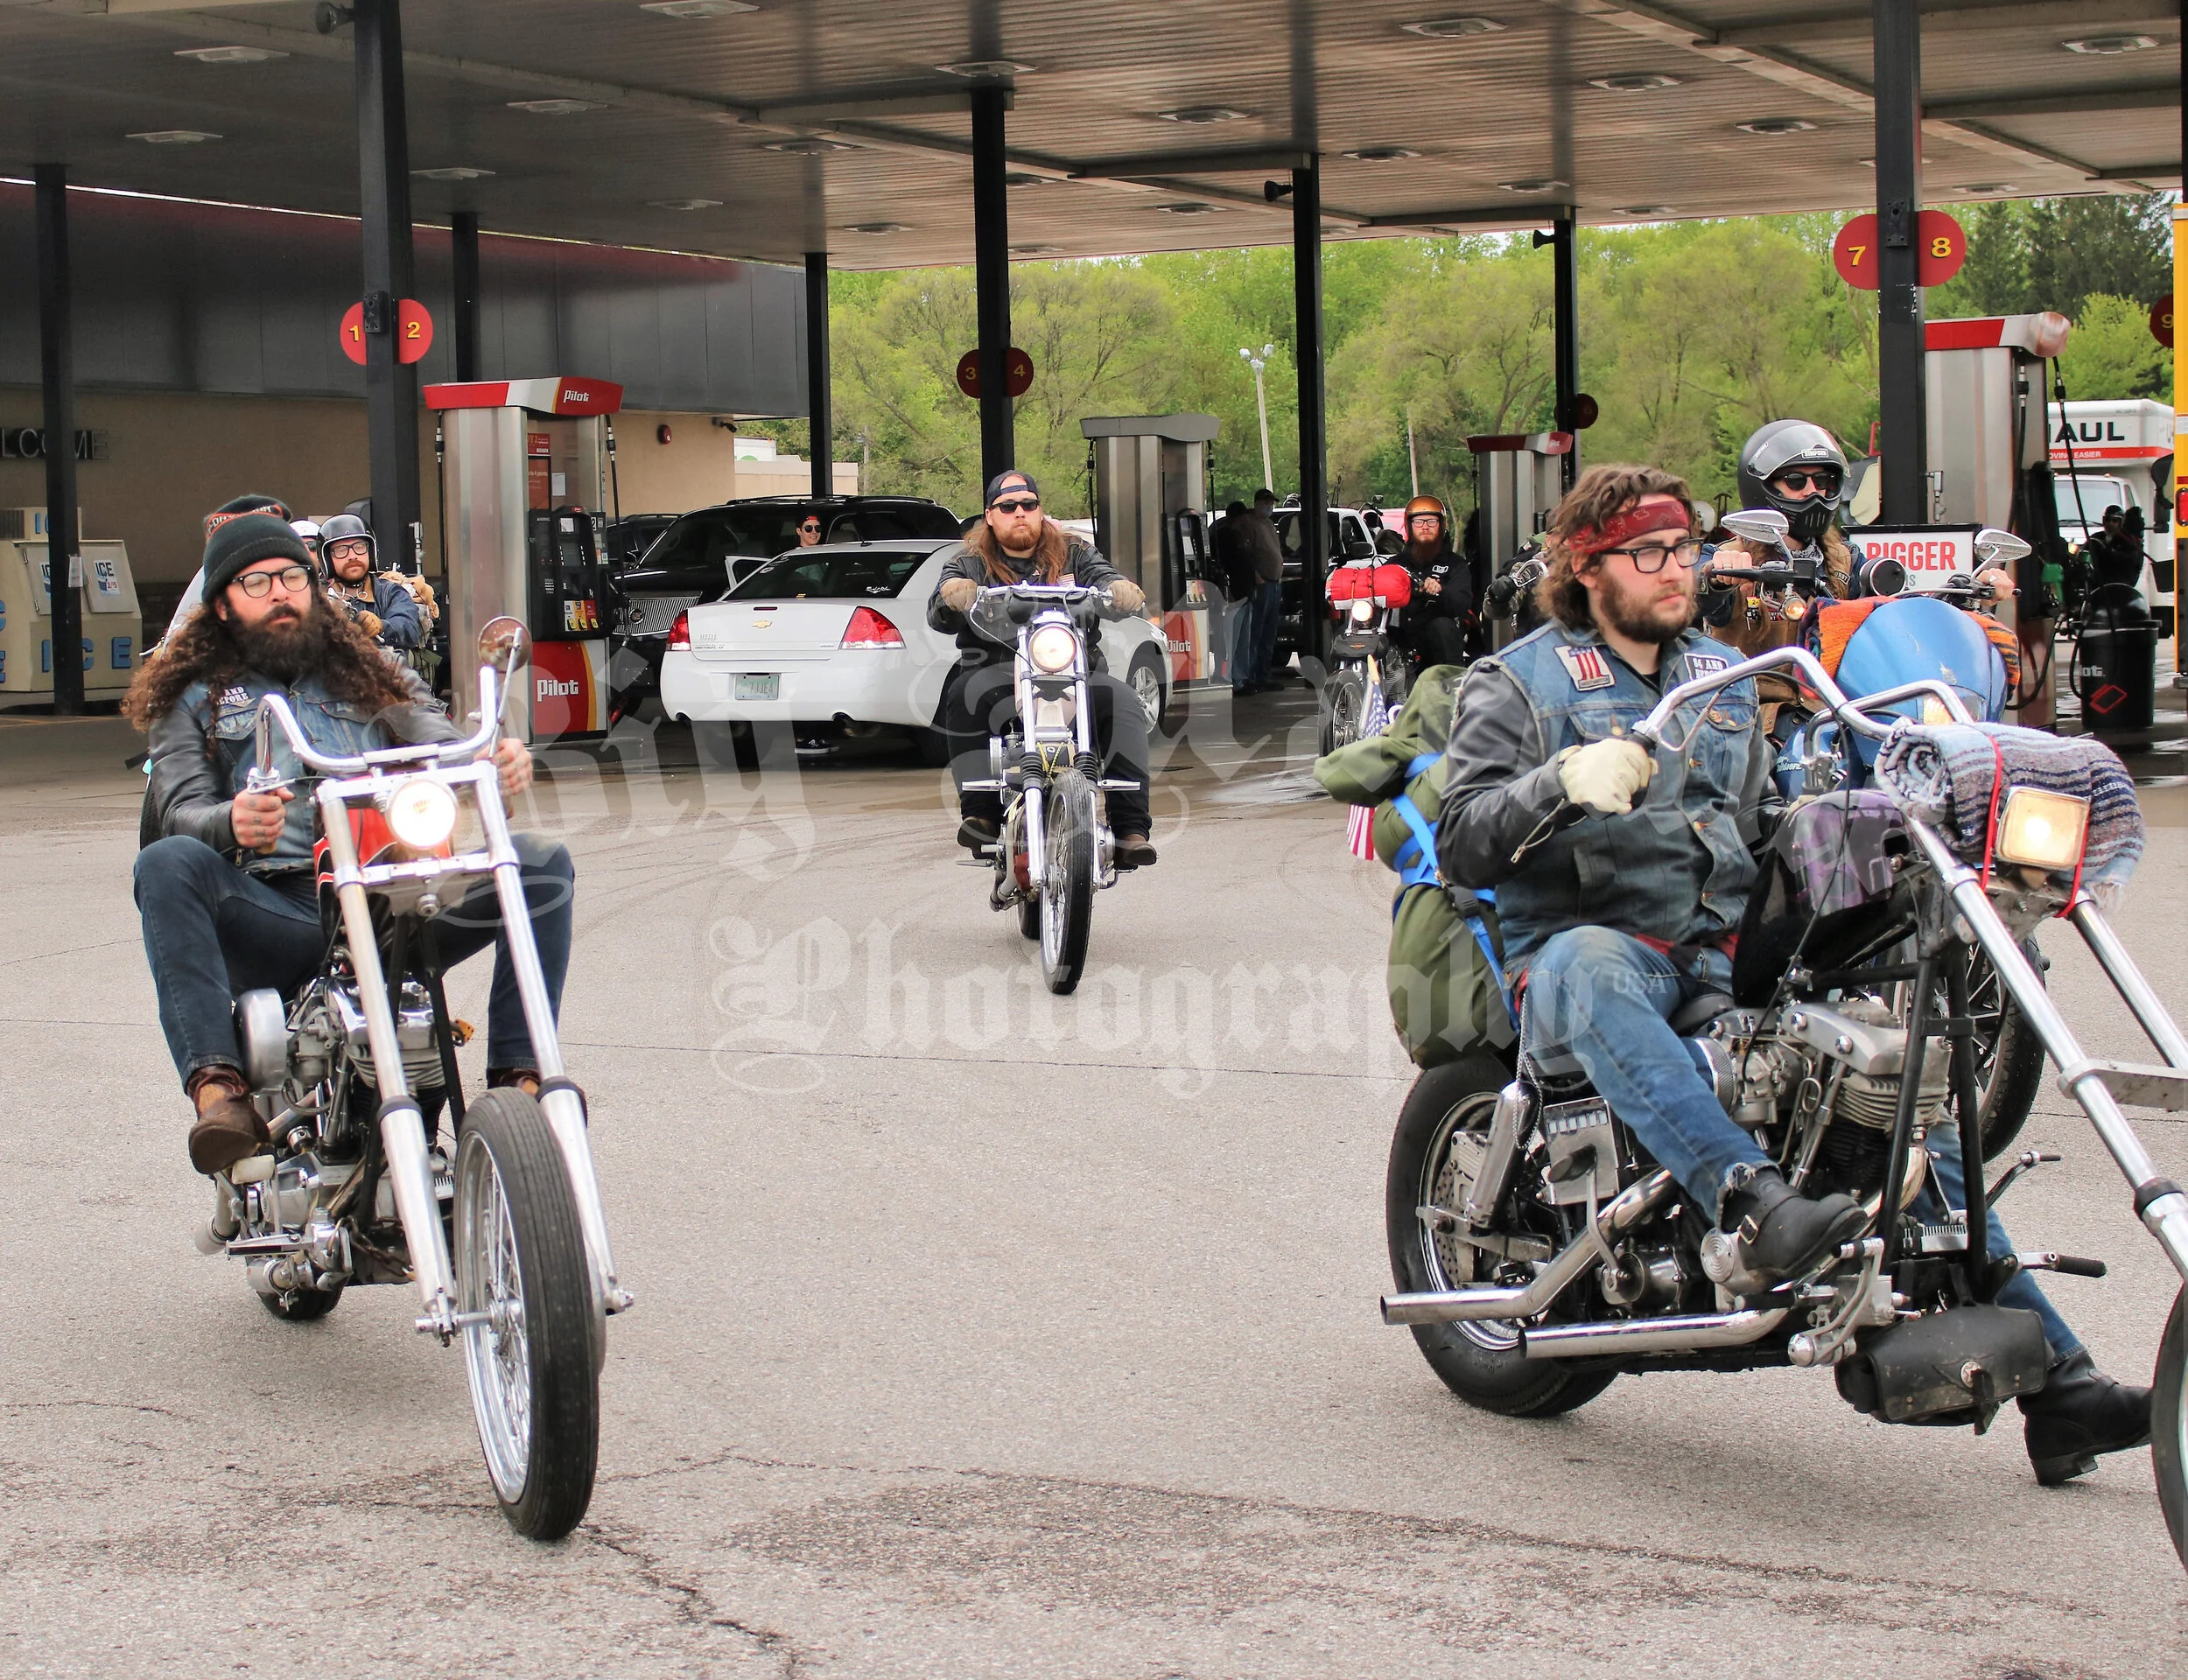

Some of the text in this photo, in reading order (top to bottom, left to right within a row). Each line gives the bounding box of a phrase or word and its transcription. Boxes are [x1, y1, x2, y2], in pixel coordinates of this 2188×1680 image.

[1932, 237, 1952, 257] 8
[1847, 246, 1866, 266] 7
[2161, 314, 2174, 328] 9
[349, 325, 360, 341] 1
[407, 321, 421, 339] 2
[965, 367, 977, 380] 3
[1013, 363, 1027, 377] 4
[563, 389, 590, 403] Pilot
[2048, 422, 2125, 443] AUL
[95, 562, 114, 577] ICE
[224, 686, 245, 696] AND
[536, 679, 579, 702] Pilot
[216, 692, 249, 705] EFORE
